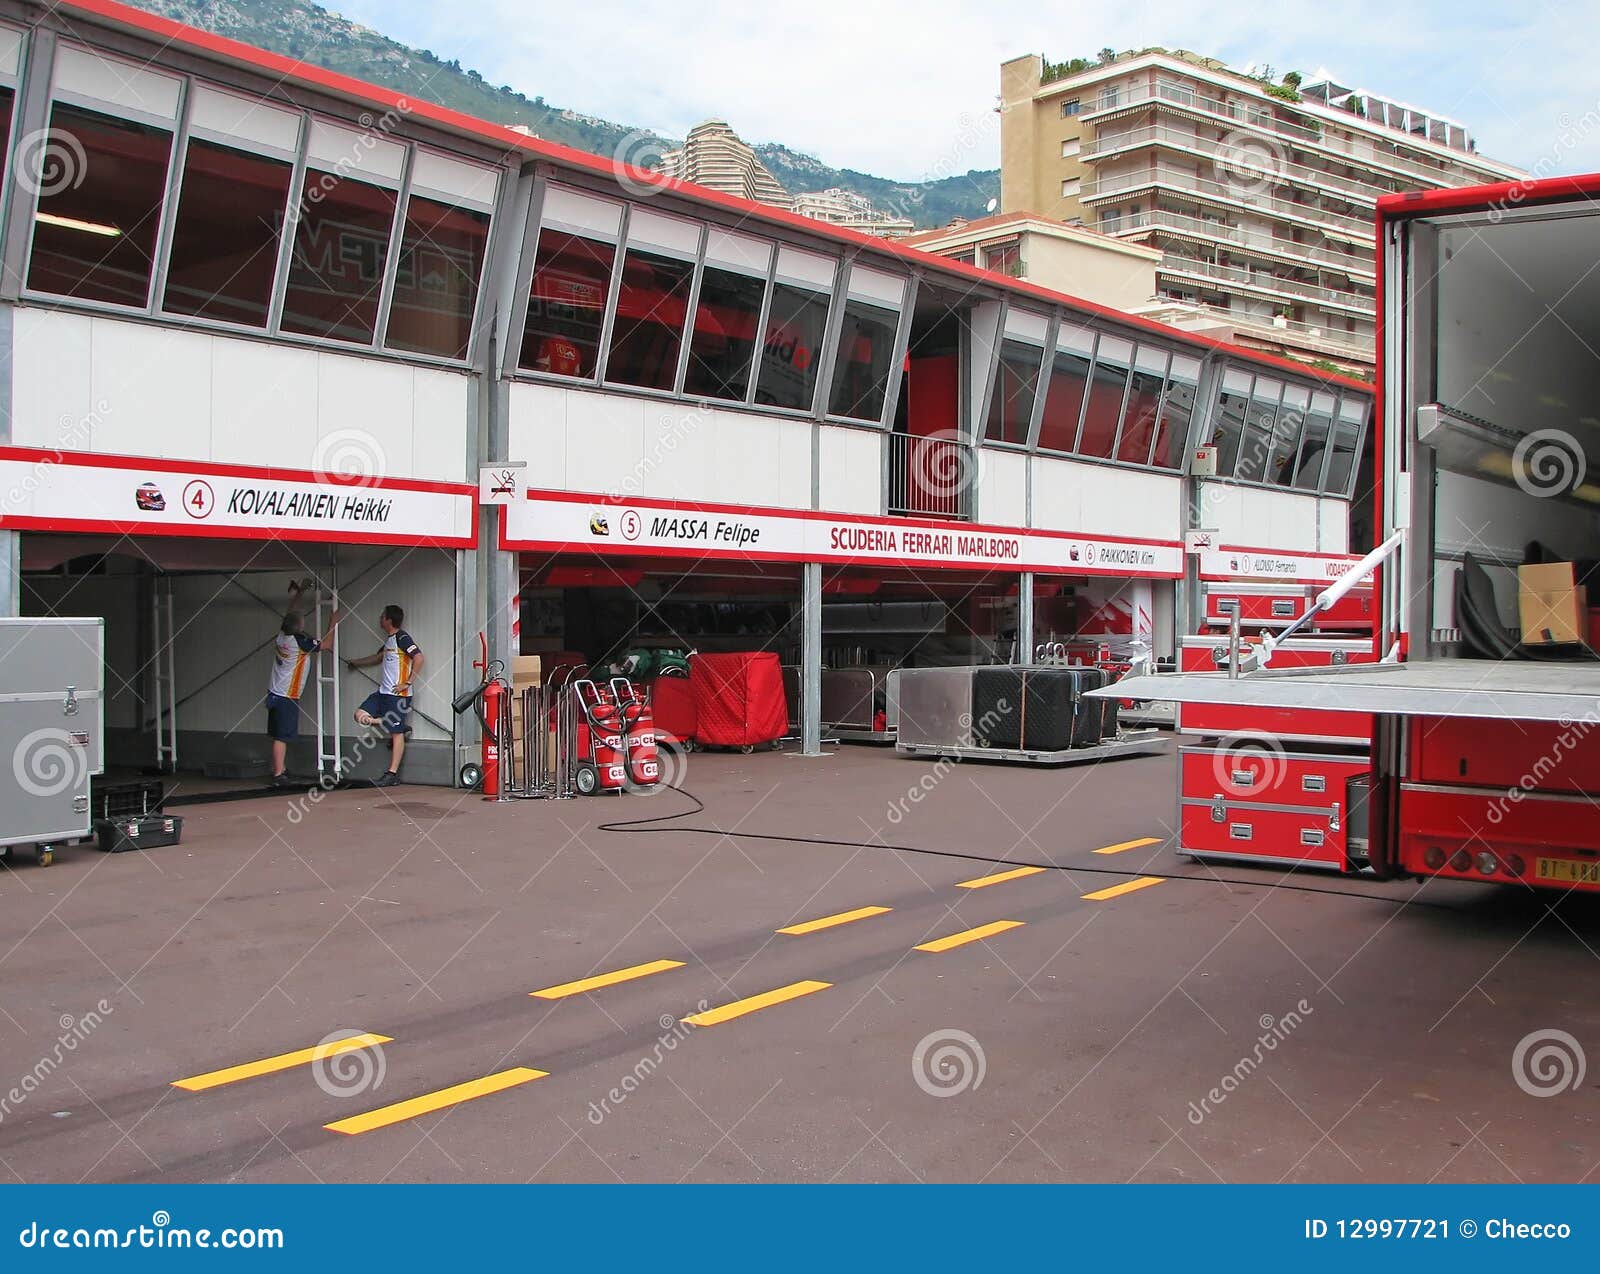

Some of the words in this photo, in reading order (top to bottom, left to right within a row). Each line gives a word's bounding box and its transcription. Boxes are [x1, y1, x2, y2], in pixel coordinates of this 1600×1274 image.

[191, 489, 204, 509] 4
[227, 488, 340, 519] KOVALAINEN
[341, 496, 392, 522] Heikki
[627, 517, 635, 534] 5
[650, 517, 708, 539] MASSA
[714, 522, 760, 547] Felipe
[830, 527, 897, 552] SCUDERIA
[903, 532, 952, 555] FERRARI
[957, 536, 1019, 559] MARLBORO
[1099, 548, 1139, 564] RAIKKONEN
[1253, 560, 1275, 572] ALONSO
[1274, 560, 1296, 574] Fernando
[1325, 562, 1355, 576] VODAFON
